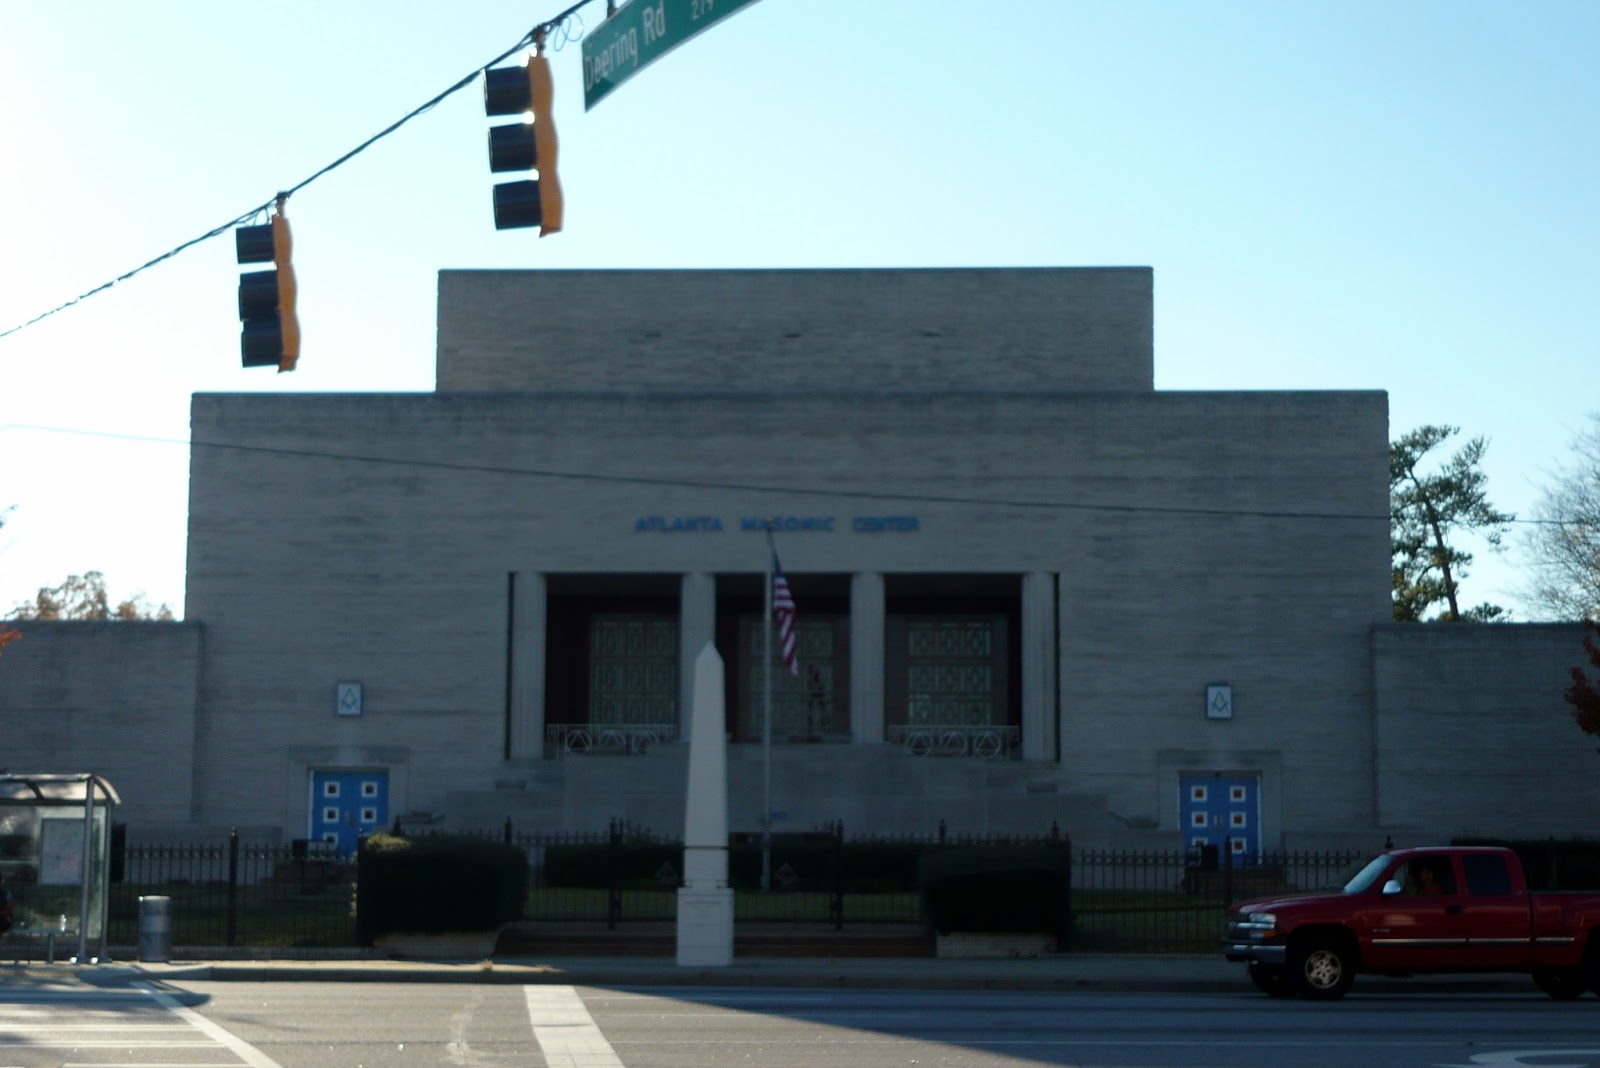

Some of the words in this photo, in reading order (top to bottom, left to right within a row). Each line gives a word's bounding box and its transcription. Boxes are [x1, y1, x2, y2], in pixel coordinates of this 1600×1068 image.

[584, 27, 639, 92] Deering
[643, 0, 666, 46] Rd
[635, 516, 723, 532] ATLANTA
[741, 516, 834, 532] MASONIC
[853, 516, 920, 532] CENTER
